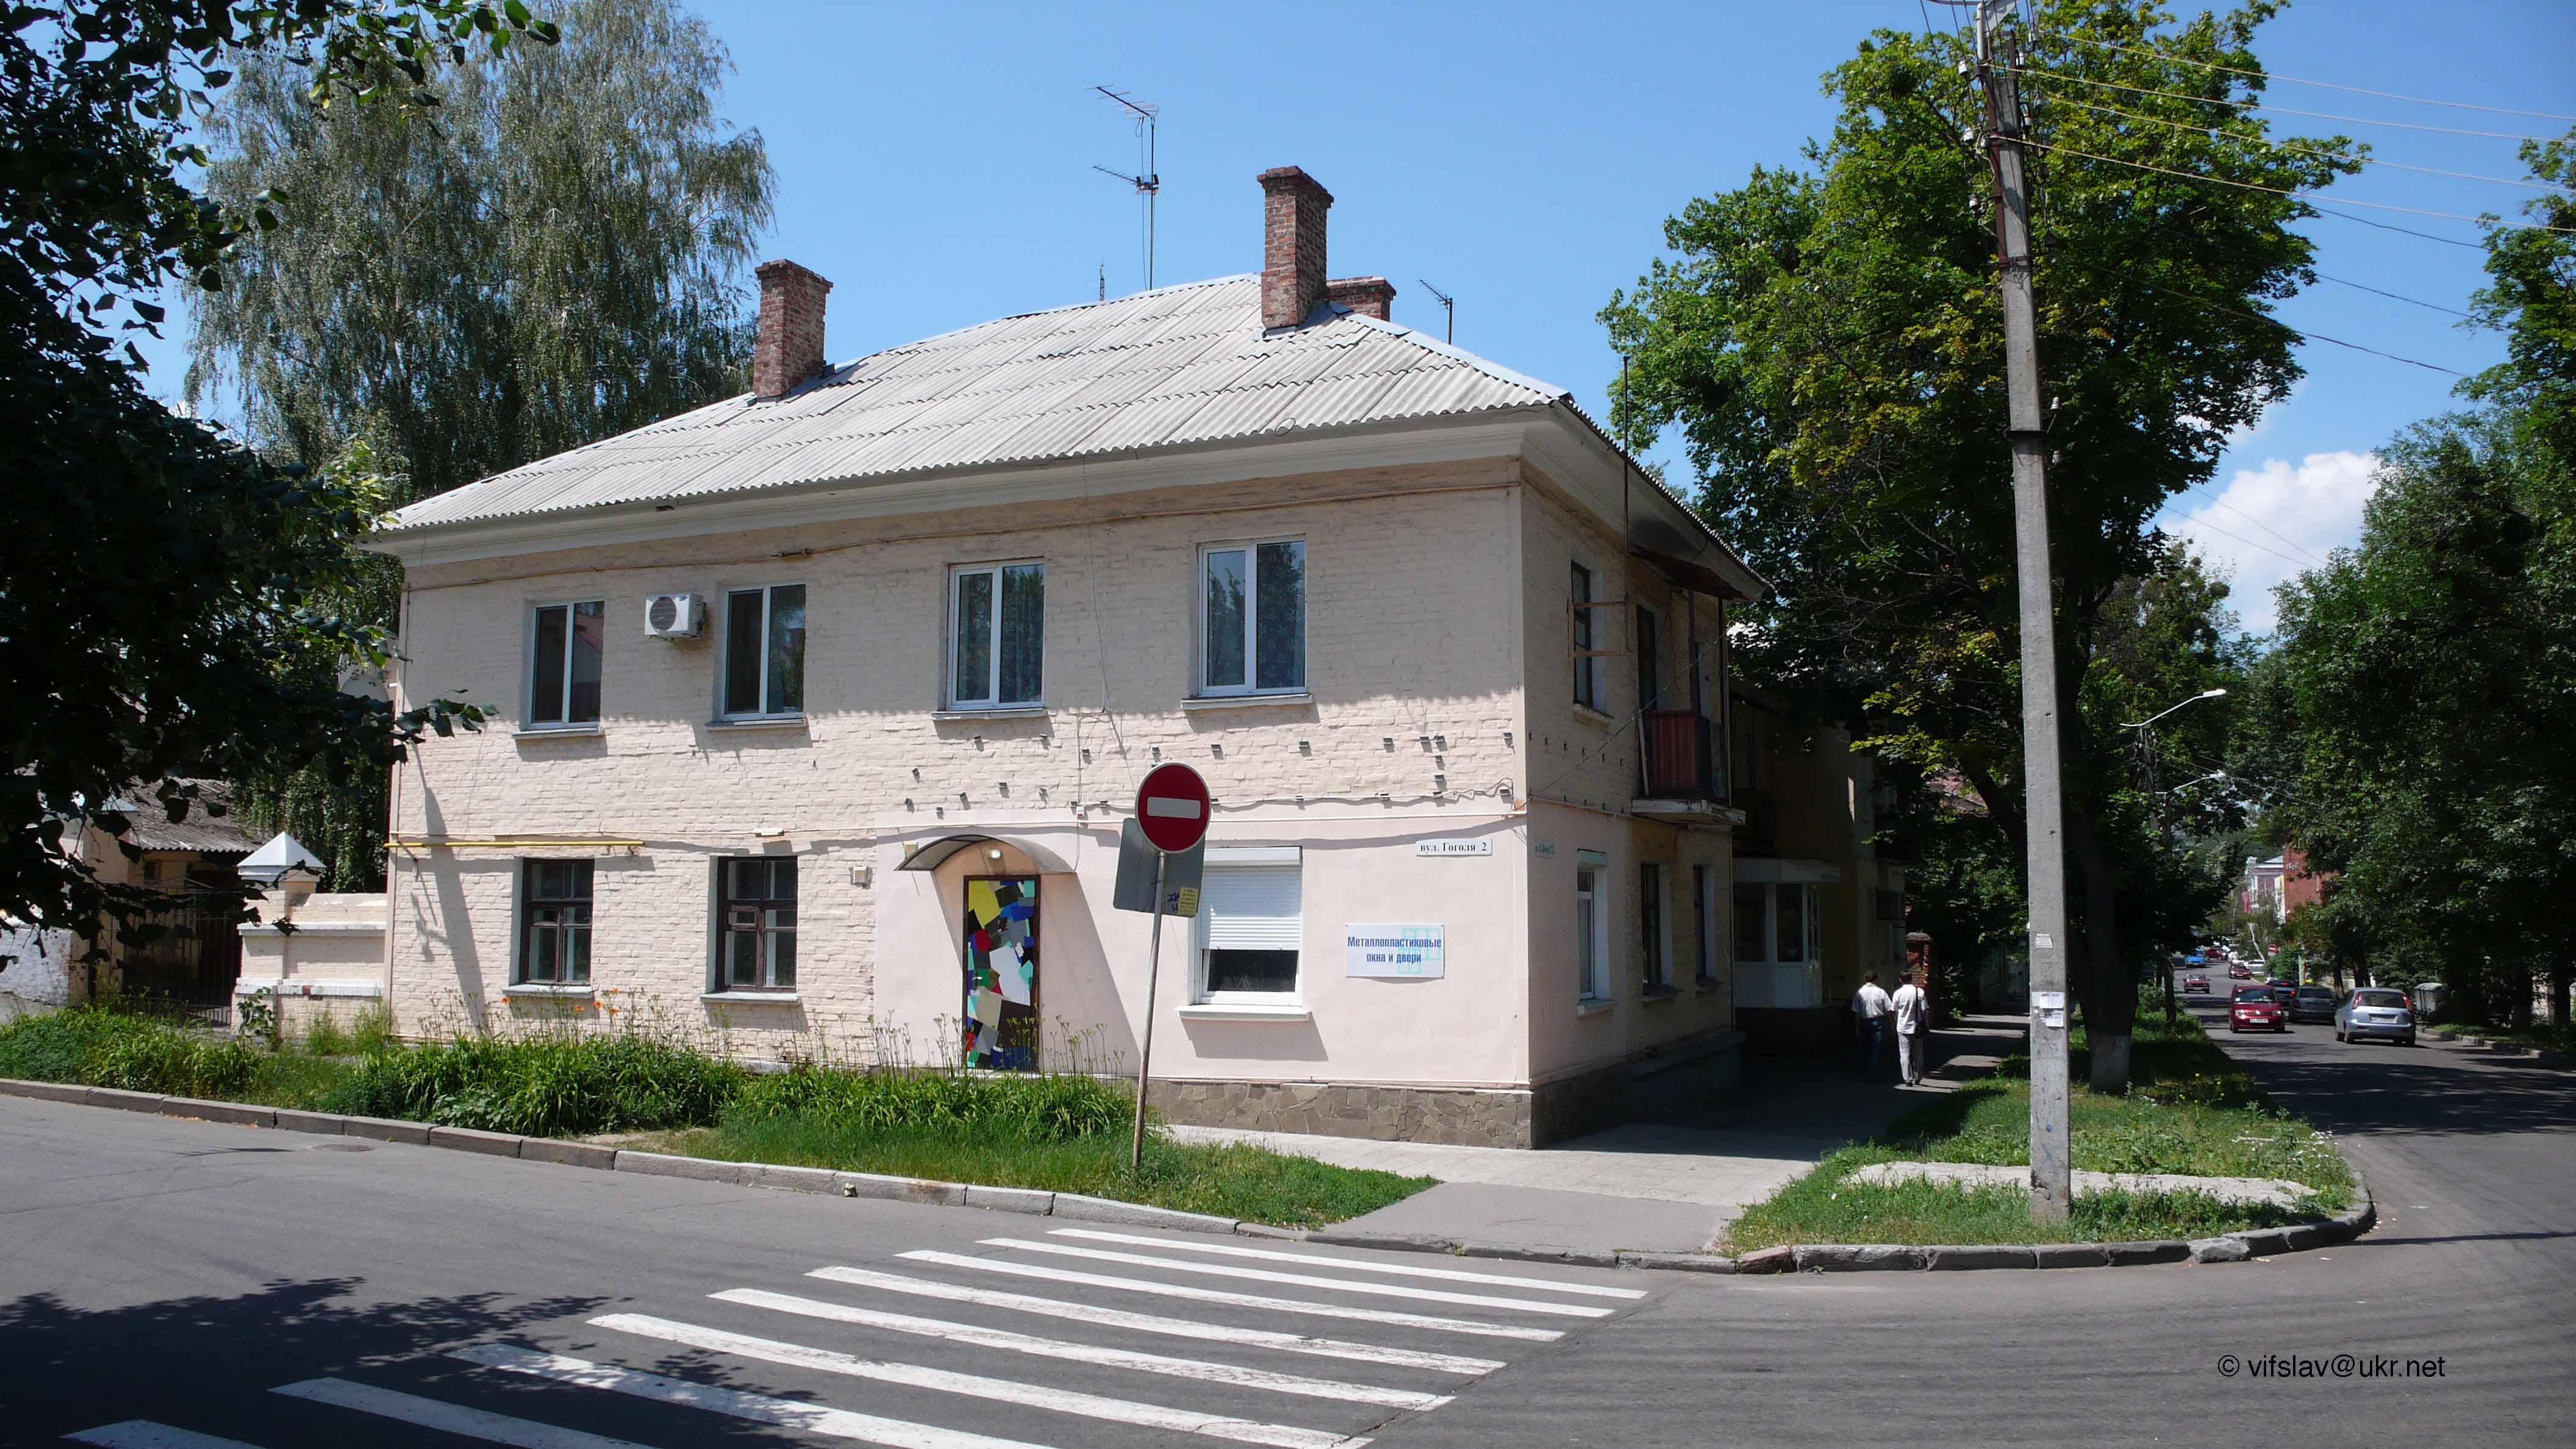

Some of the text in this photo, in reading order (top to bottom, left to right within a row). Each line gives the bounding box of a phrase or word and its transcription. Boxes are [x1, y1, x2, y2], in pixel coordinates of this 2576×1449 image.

[1420, 842, 1487, 854] вул. Гоголя 2
[1347, 936, 1442, 948] Металлопластиковые
[1366, 953, 1422, 964] окна и двери
